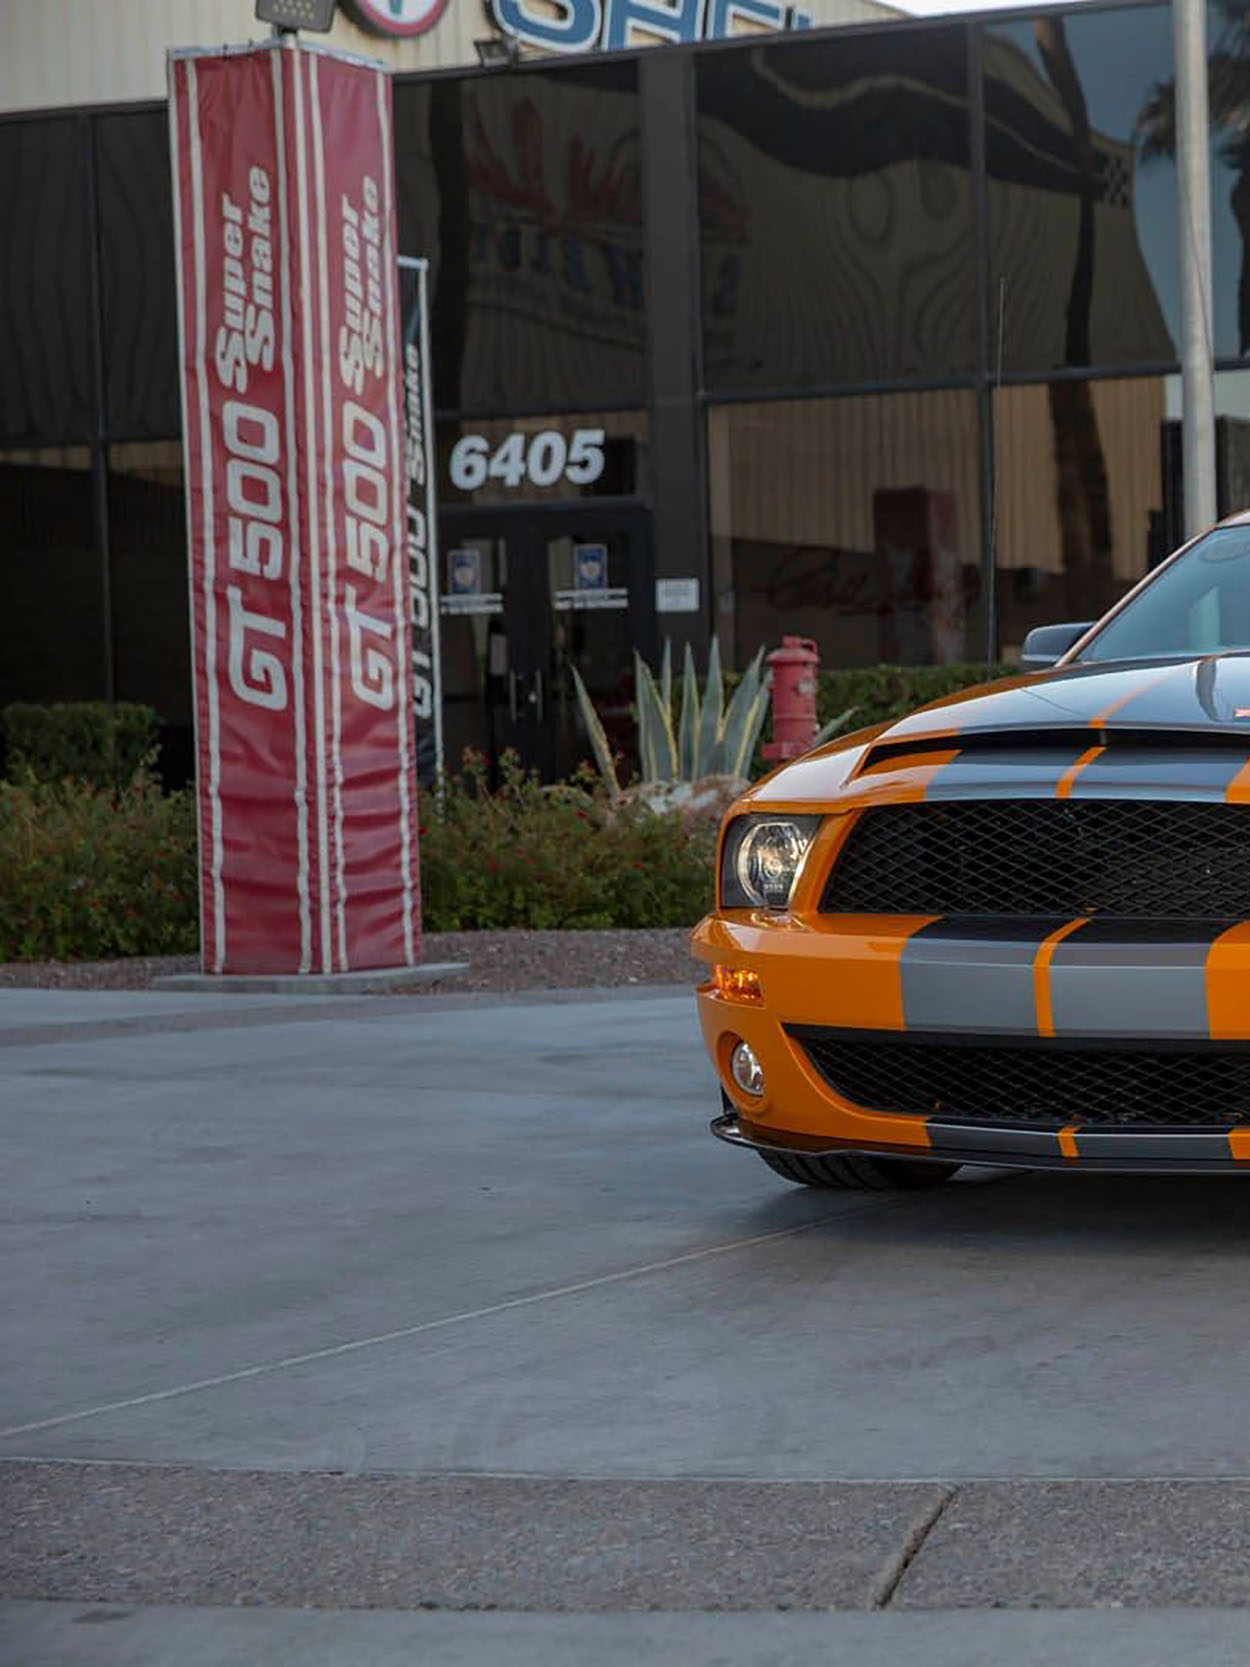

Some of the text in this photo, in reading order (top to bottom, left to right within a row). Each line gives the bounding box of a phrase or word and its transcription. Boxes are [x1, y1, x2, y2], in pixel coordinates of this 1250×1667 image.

[216, 192, 247, 395] Super
[245, 165, 275, 372] Snake
[340, 194, 364, 396] Super
[362, 176, 384, 379] Snake
[222, 401, 287, 711] GT 500
[342, 401, 394, 711] GT 500
[450, 428, 605, 490] 6405
